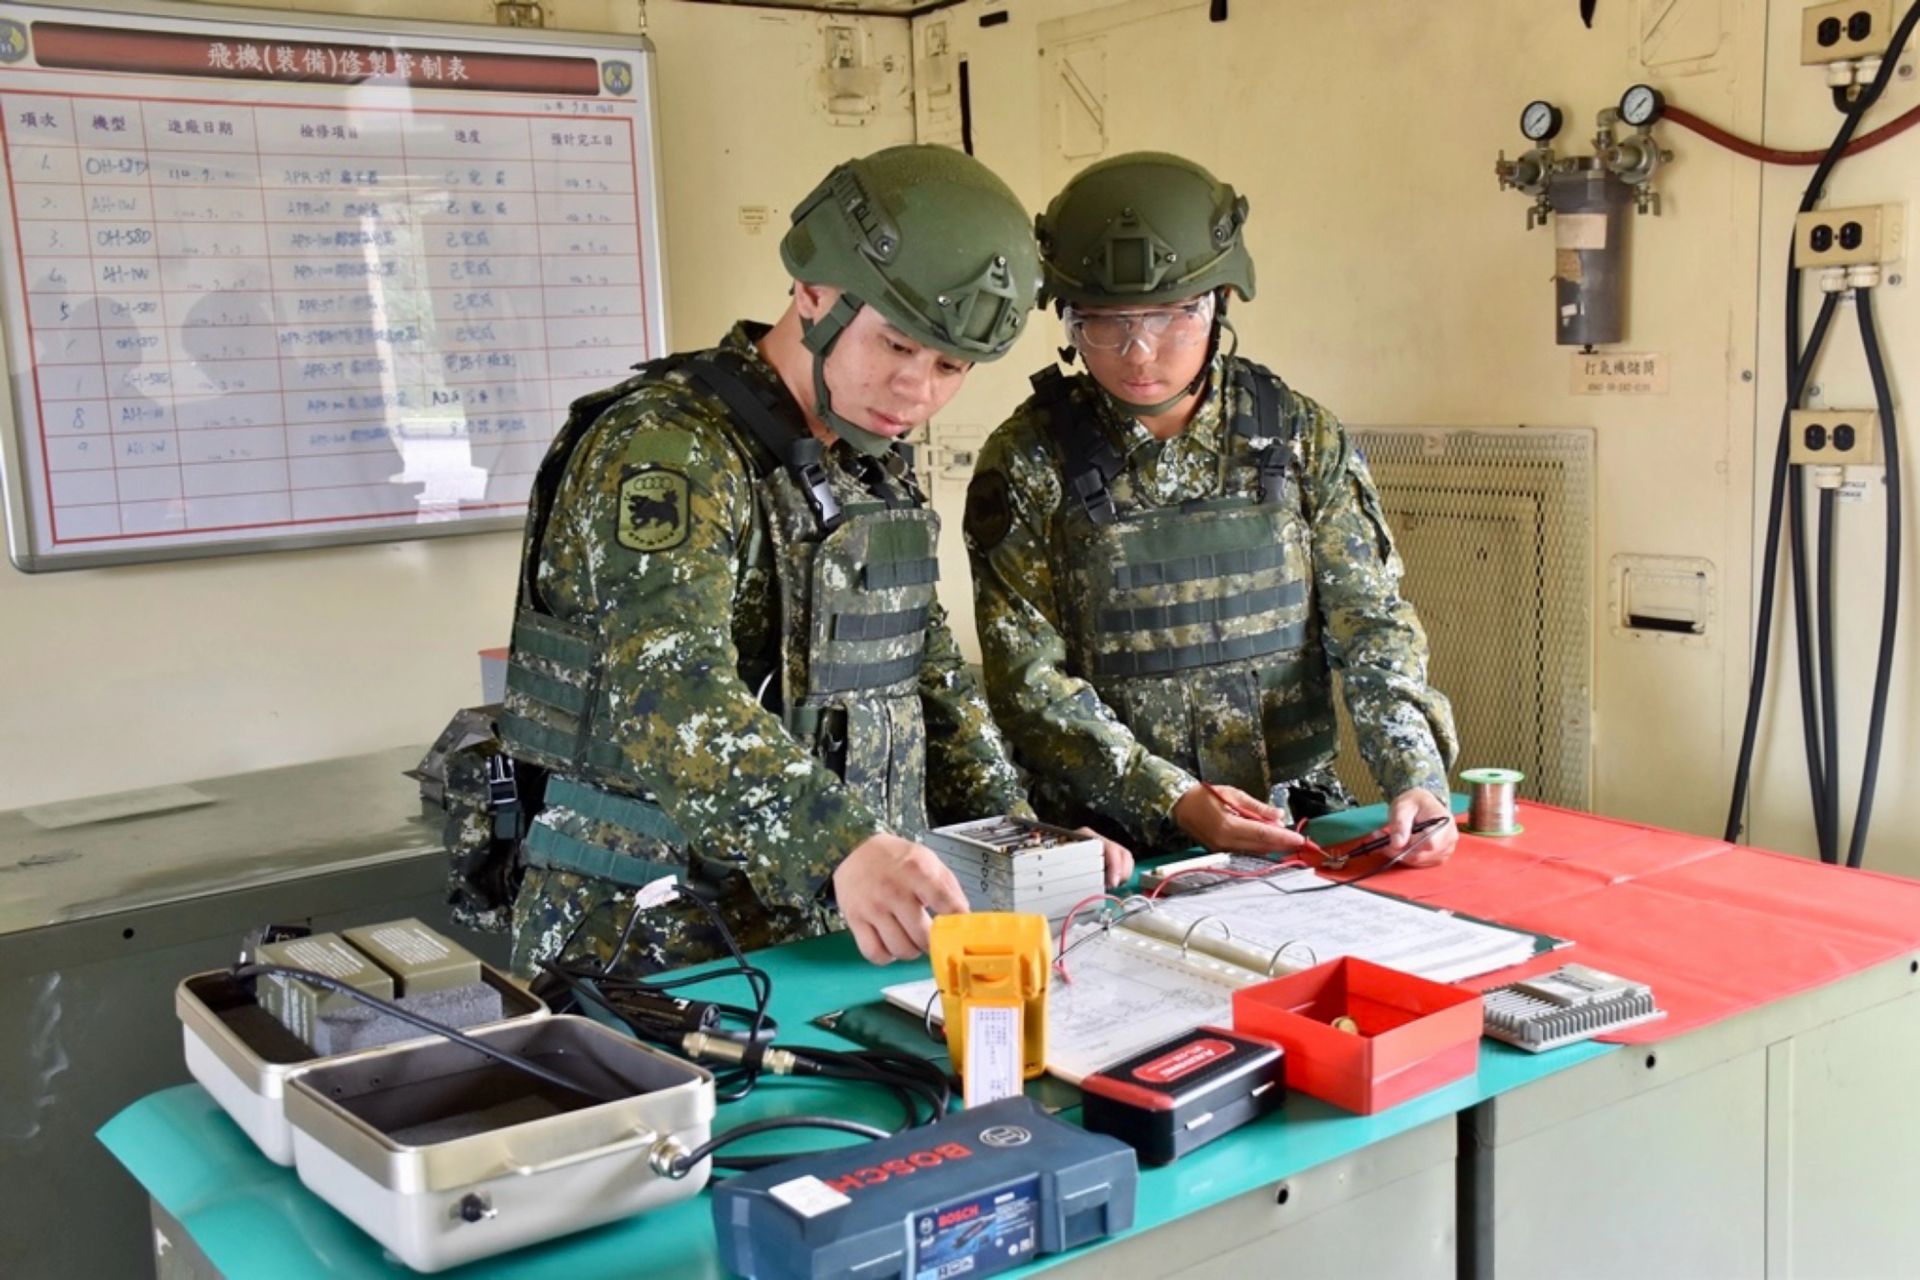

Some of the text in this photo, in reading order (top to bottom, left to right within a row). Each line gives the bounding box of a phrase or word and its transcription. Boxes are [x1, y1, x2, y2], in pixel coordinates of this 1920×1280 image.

[207, 42, 470, 81] 飛機(裝備)修製管制表
[20, 112, 58, 129] 項次
[92, 115, 127, 132] 機型
[168, 119, 233, 136] 進廠日期
[455, 129, 481, 144] 進度
[826, 1142, 974, 1194] BOSCH
[938, 1203, 980, 1228] BOSCH
